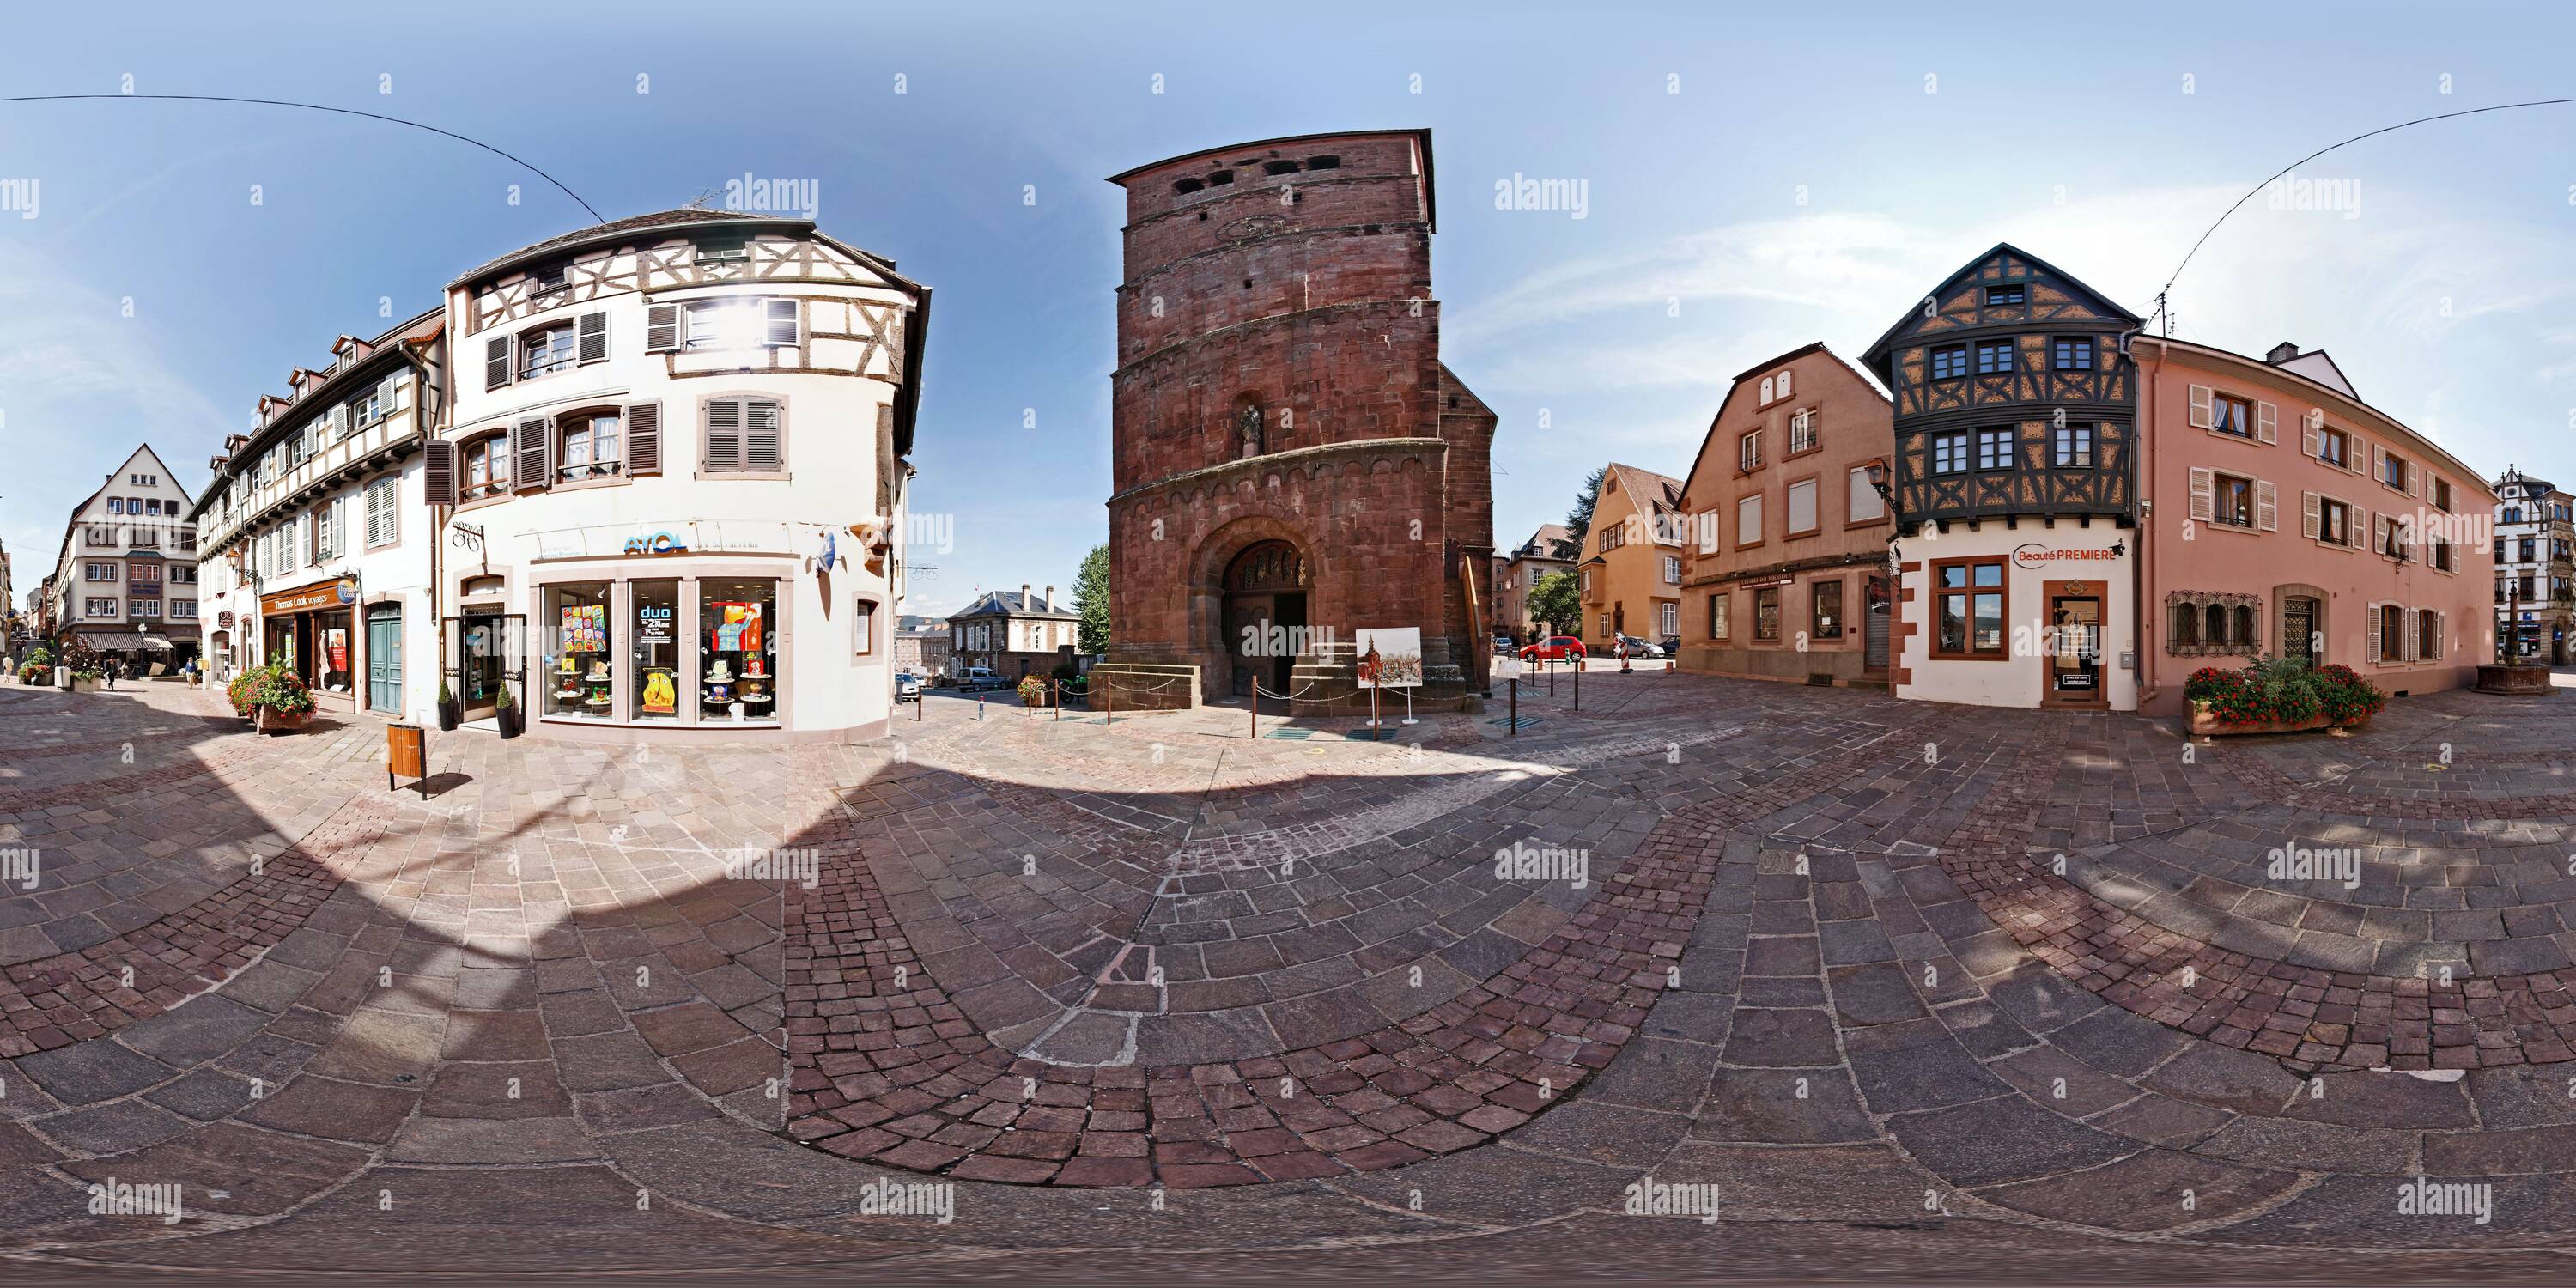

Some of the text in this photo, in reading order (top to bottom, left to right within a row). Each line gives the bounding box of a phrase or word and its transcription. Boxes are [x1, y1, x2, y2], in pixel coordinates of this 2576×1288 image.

[624, 531, 687, 554] ATOL
[2019, 550, 2116, 561] Beauté PREMIERE
[274, 594, 327, 610] Thomas Cook voyages
[641, 605, 671, 618] duo
[647, 619, 655, 628] 2
